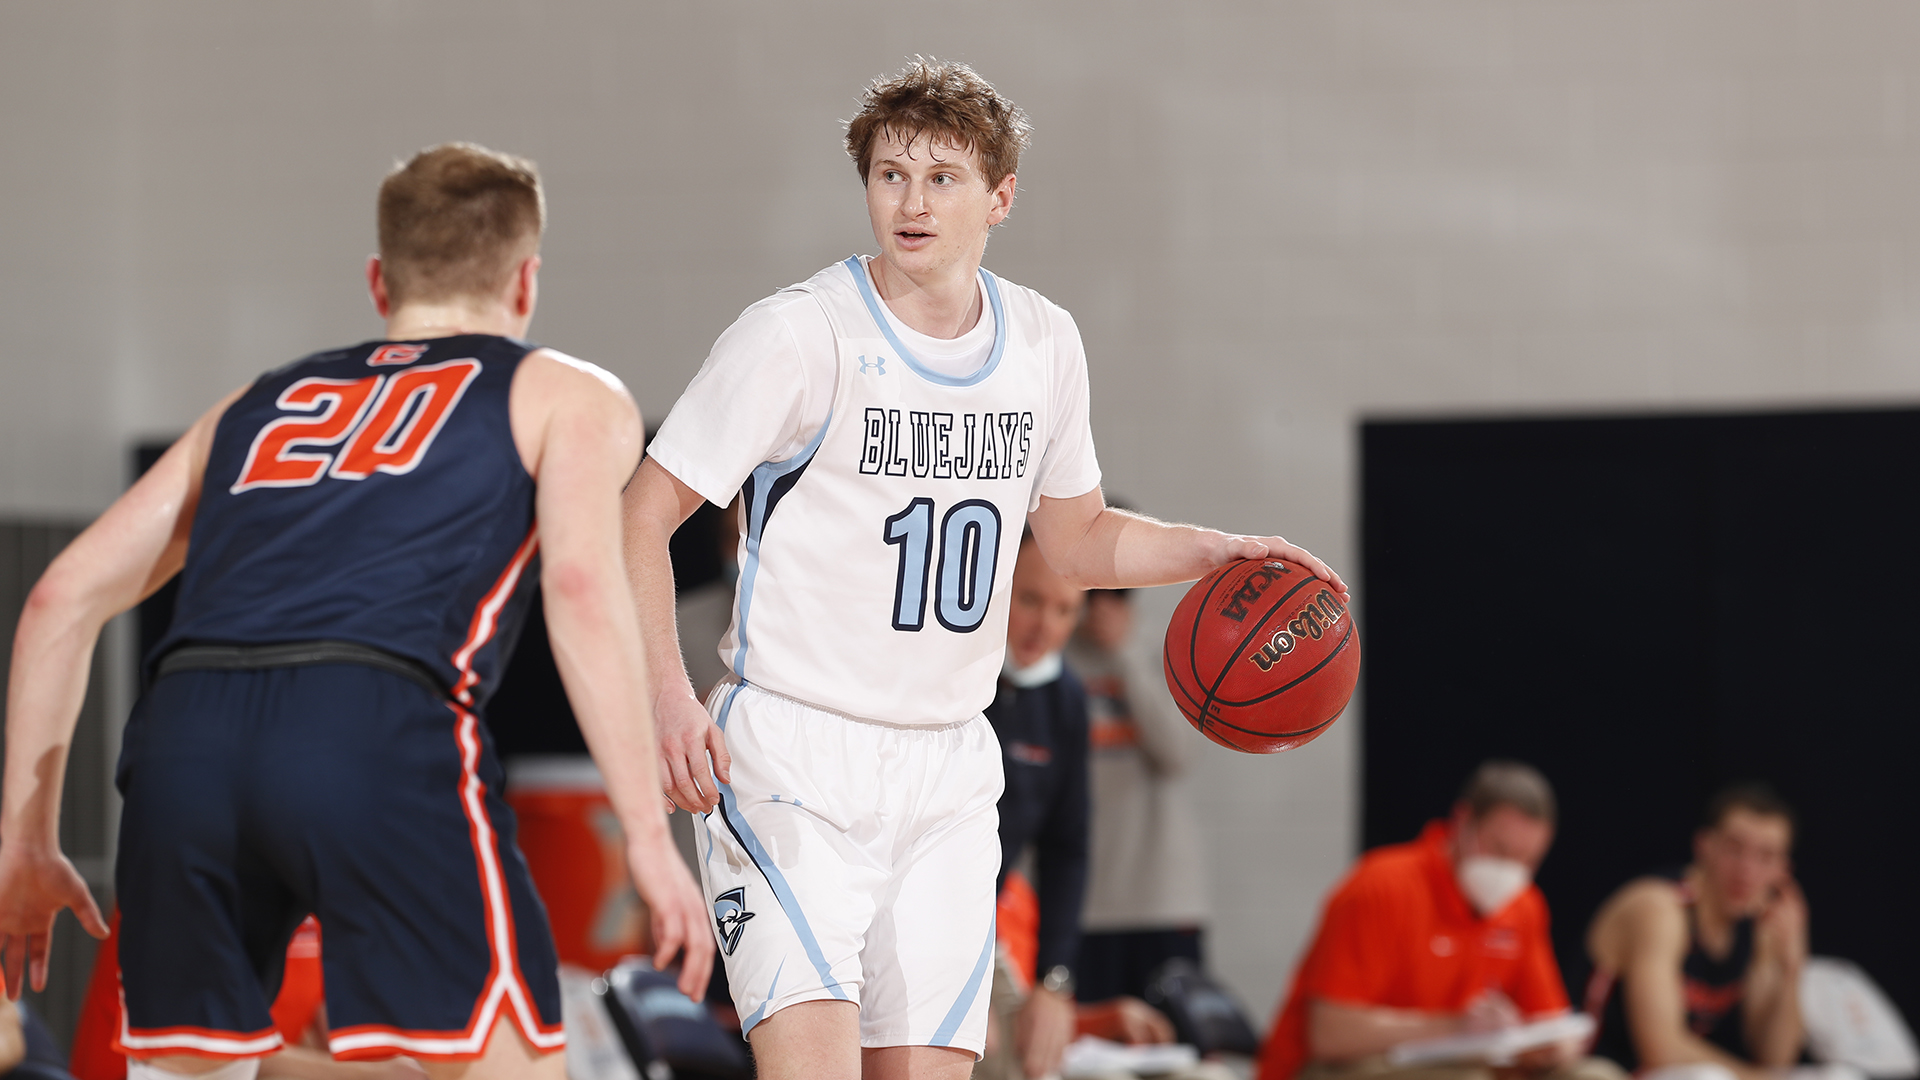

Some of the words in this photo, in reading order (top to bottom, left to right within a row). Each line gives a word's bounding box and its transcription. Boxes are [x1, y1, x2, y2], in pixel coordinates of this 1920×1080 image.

[229, 357, 483, 495] 20
[859, 407, 1033, 480] BLUEJAYS
[883, 497, 1002, 634] 10
[1220, 563, 1292, 623] NCAA
[1248, 588, 1346, 672] Wilson
